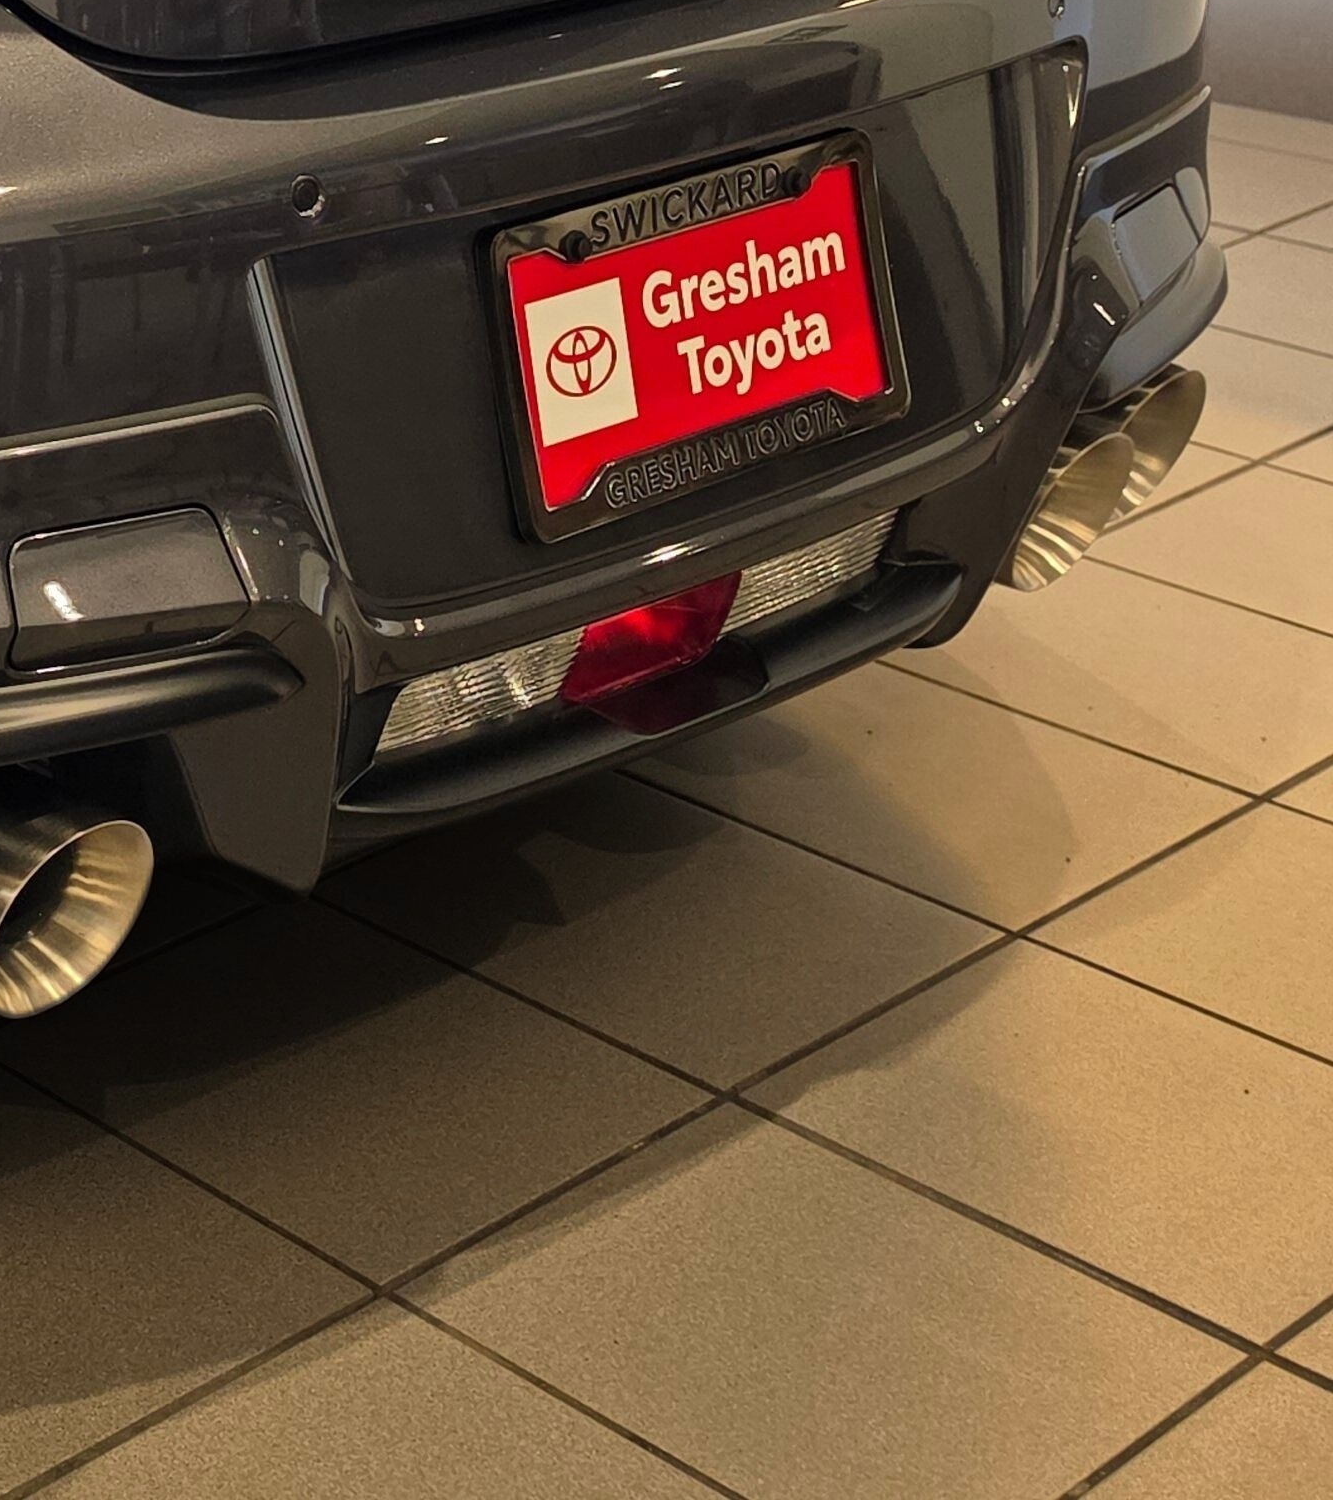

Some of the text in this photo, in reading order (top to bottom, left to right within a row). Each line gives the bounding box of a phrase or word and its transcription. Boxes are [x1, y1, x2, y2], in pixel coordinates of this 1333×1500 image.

[589, 161, 781, 248] SWICKARD
[641, 231, 846, 328] Gresham
[677, 309, 831, 395] Toyota
[604, 399, 847, 509] GRESHAM TOYOTA
